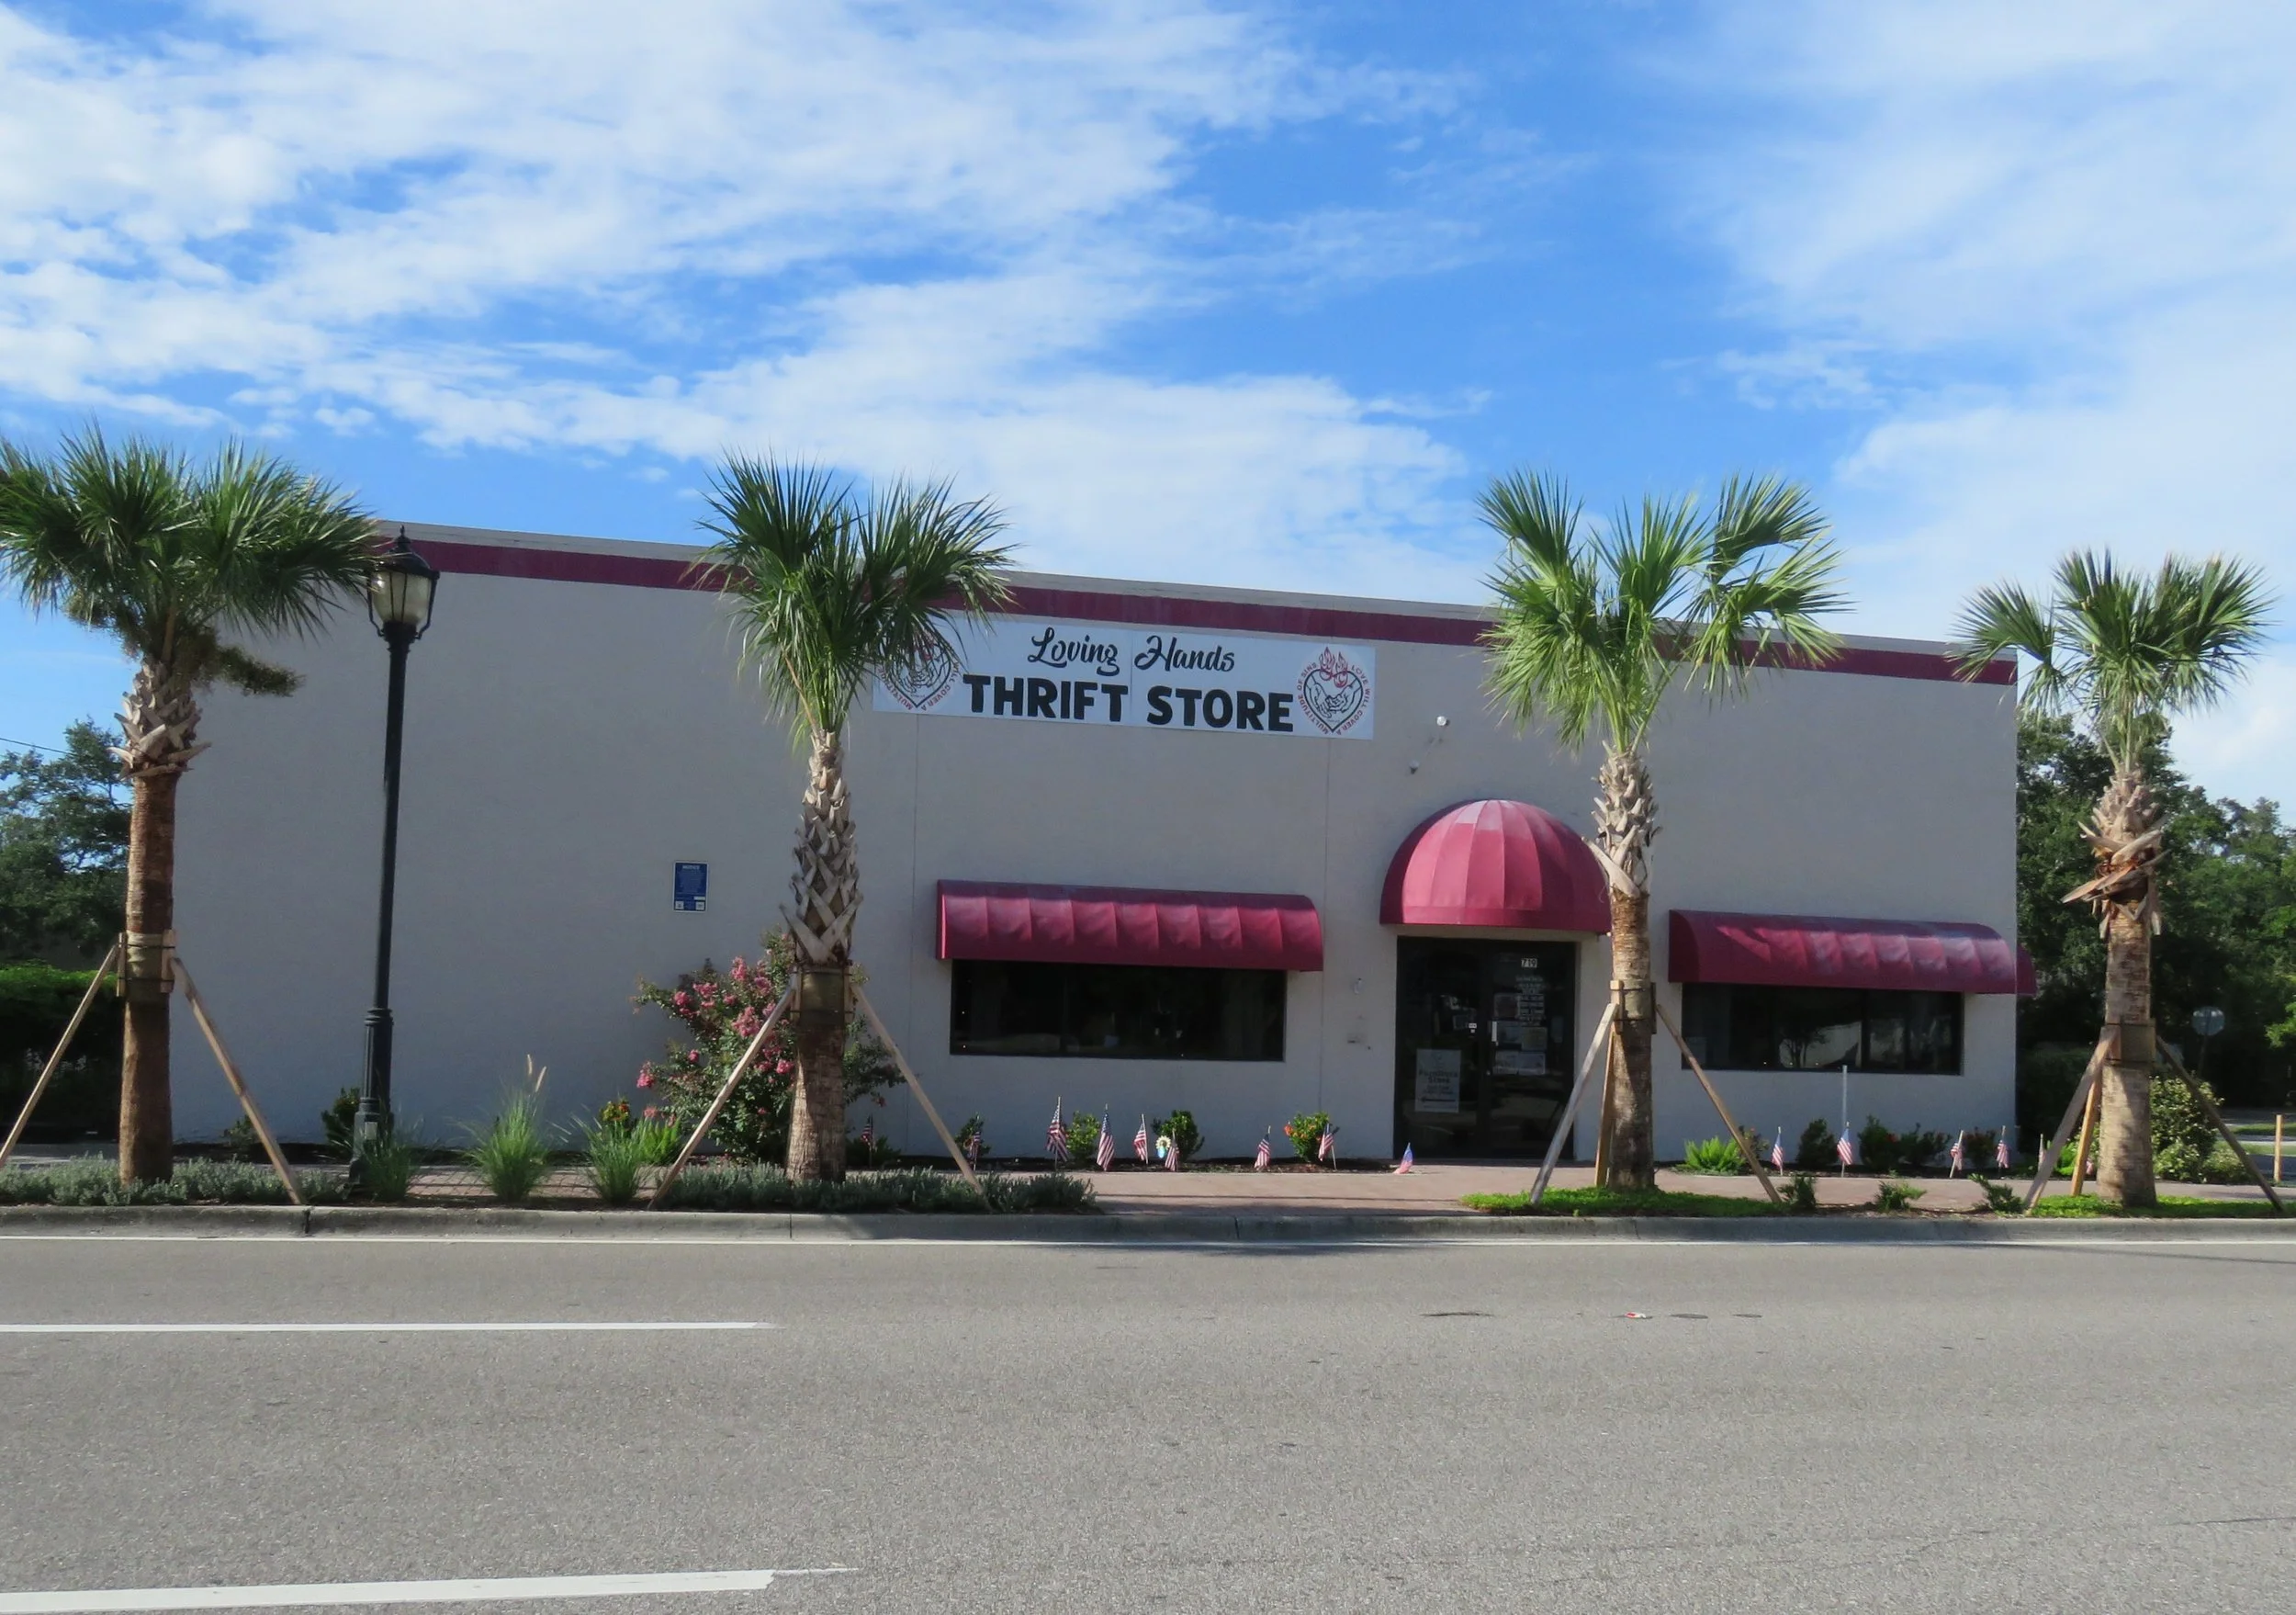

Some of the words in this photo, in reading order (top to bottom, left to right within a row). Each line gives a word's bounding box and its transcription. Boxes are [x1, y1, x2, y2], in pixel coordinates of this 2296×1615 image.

[1028, 627, 1120, 676] Loving
[1134, 635, 1235, 672] Hands
[1301, 662, 1317, 677] SINS
[1351, 664, 1368, 685] LOVE
[929, 685, 951, 706] COVER
[1297, 680, 1302, 691] OF
[962, 673, 1128, 722] THRIFT
[1146, 684, 1294, 733] STORE
[1361, 688, 1370, 708] WILL
[1298, 694, 1329, 734] MULTITUDE
[1342, 709, 1363, 731] COVER
